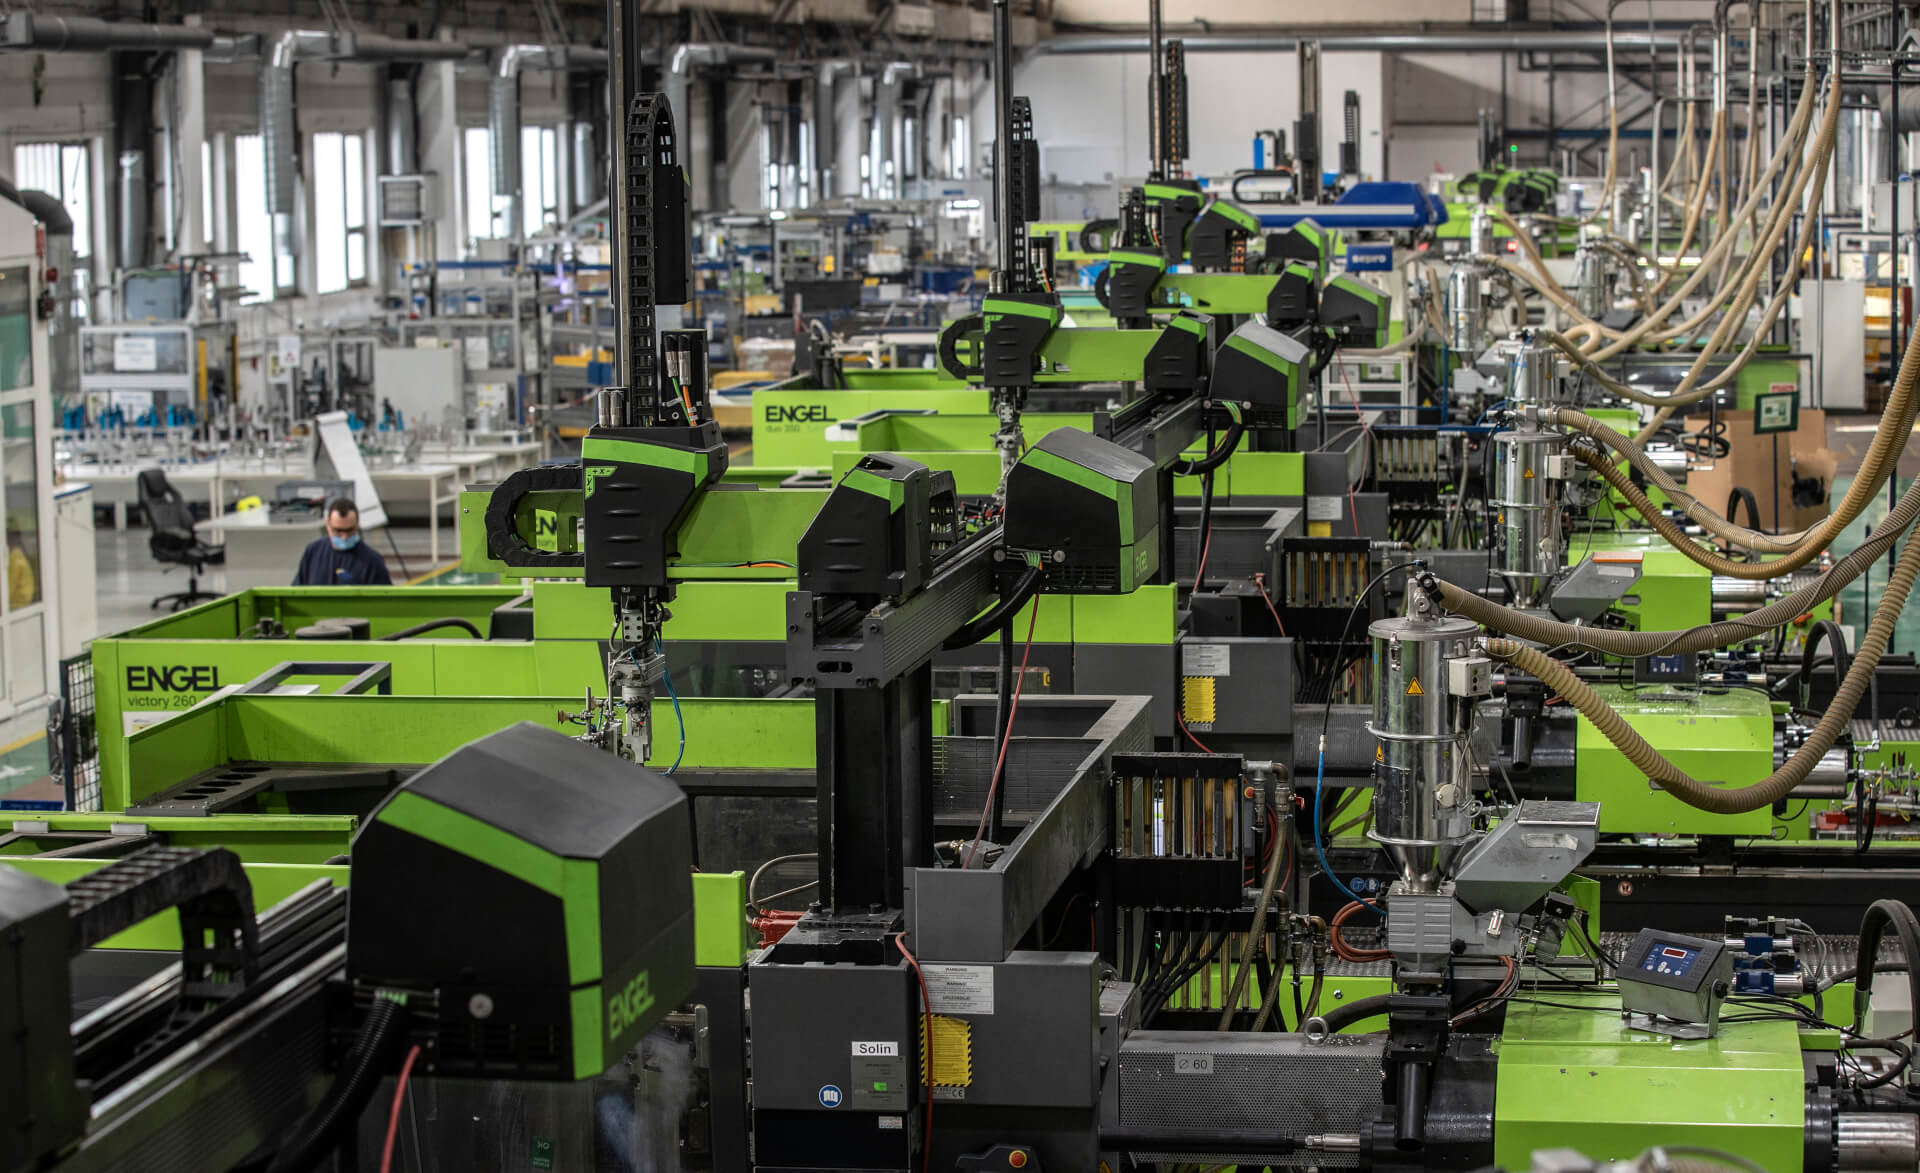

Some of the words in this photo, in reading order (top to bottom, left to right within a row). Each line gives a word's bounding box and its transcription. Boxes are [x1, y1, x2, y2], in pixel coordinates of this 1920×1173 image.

[765, 404, 838, 422] ENGEL
[126, 665, 224, 692] ENGEL
[128, 694, 170, 709] victory
[173, 695, 198, 707] 260
[859, 1043, 891, 1054] Solin
[1193, 1059, 1208, 1070] 60
